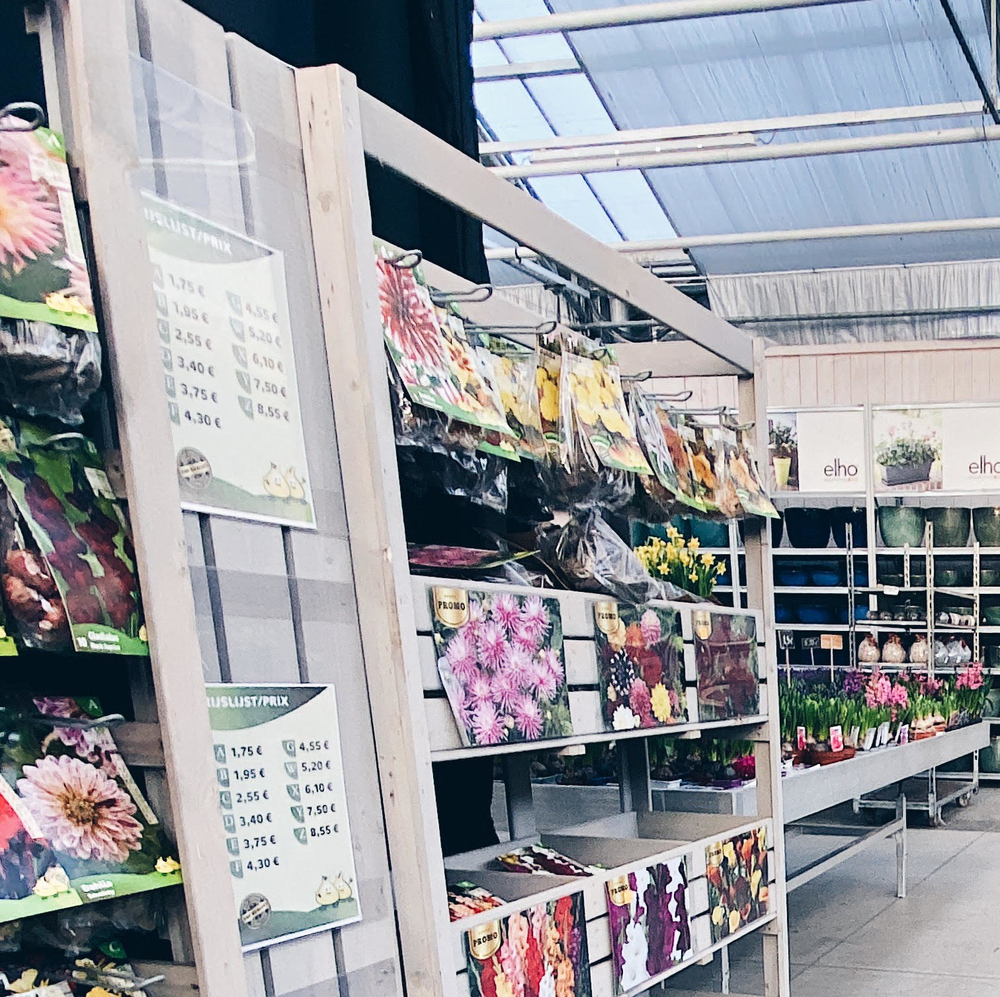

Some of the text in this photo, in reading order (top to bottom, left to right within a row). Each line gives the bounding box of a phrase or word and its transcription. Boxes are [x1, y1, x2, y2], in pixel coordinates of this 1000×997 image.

[175, 328, 202, 347] 2,55
[178, 355, 204, 374] 3,40
[252, 353, 275, 369] 6,10
[181, 383, 208, 401] 3,75
[253, 378, 278, 395] 7,50
[184, 410, 212, 426] 4,30
[257, 403, 281, 419] 8,55
[823, 458, 858, 477] elho
[437, 600, 466, 610] PROMO
[231, 745, 254, 758] 1,75
[256, 745, 263, 756] €
[299, 740, 321, 752] 4,55
[324, 740, 329, 750] €
[301, 760, 323, 772] 5,20
[325, 760, 331, 770] €
[234, 768, 257, 781] 1,95
[259, 767, 265, 778] €
[305, 783, 325, 794] 6,10
[327, 782, 333, 791] €
[236, 791, 260, 803] 2,55
[262, 790, 269, 800] €
[307, 804, 328, 816] 7,50
[330, 803, 336, 813] €
[240, 813, 264, 827] 3,40
[266, 812, 273, 823] €
[310, 825, 331, 838] 8,55
[333, 823, 339, 833] €
[243, 836, 268, 850] 3,75
[270, 835, 276, 845] €
[247, 857, 271, 871] 4,30
[273, 856, 280, 866] €
[473, 931, 498, 948] PROMO
